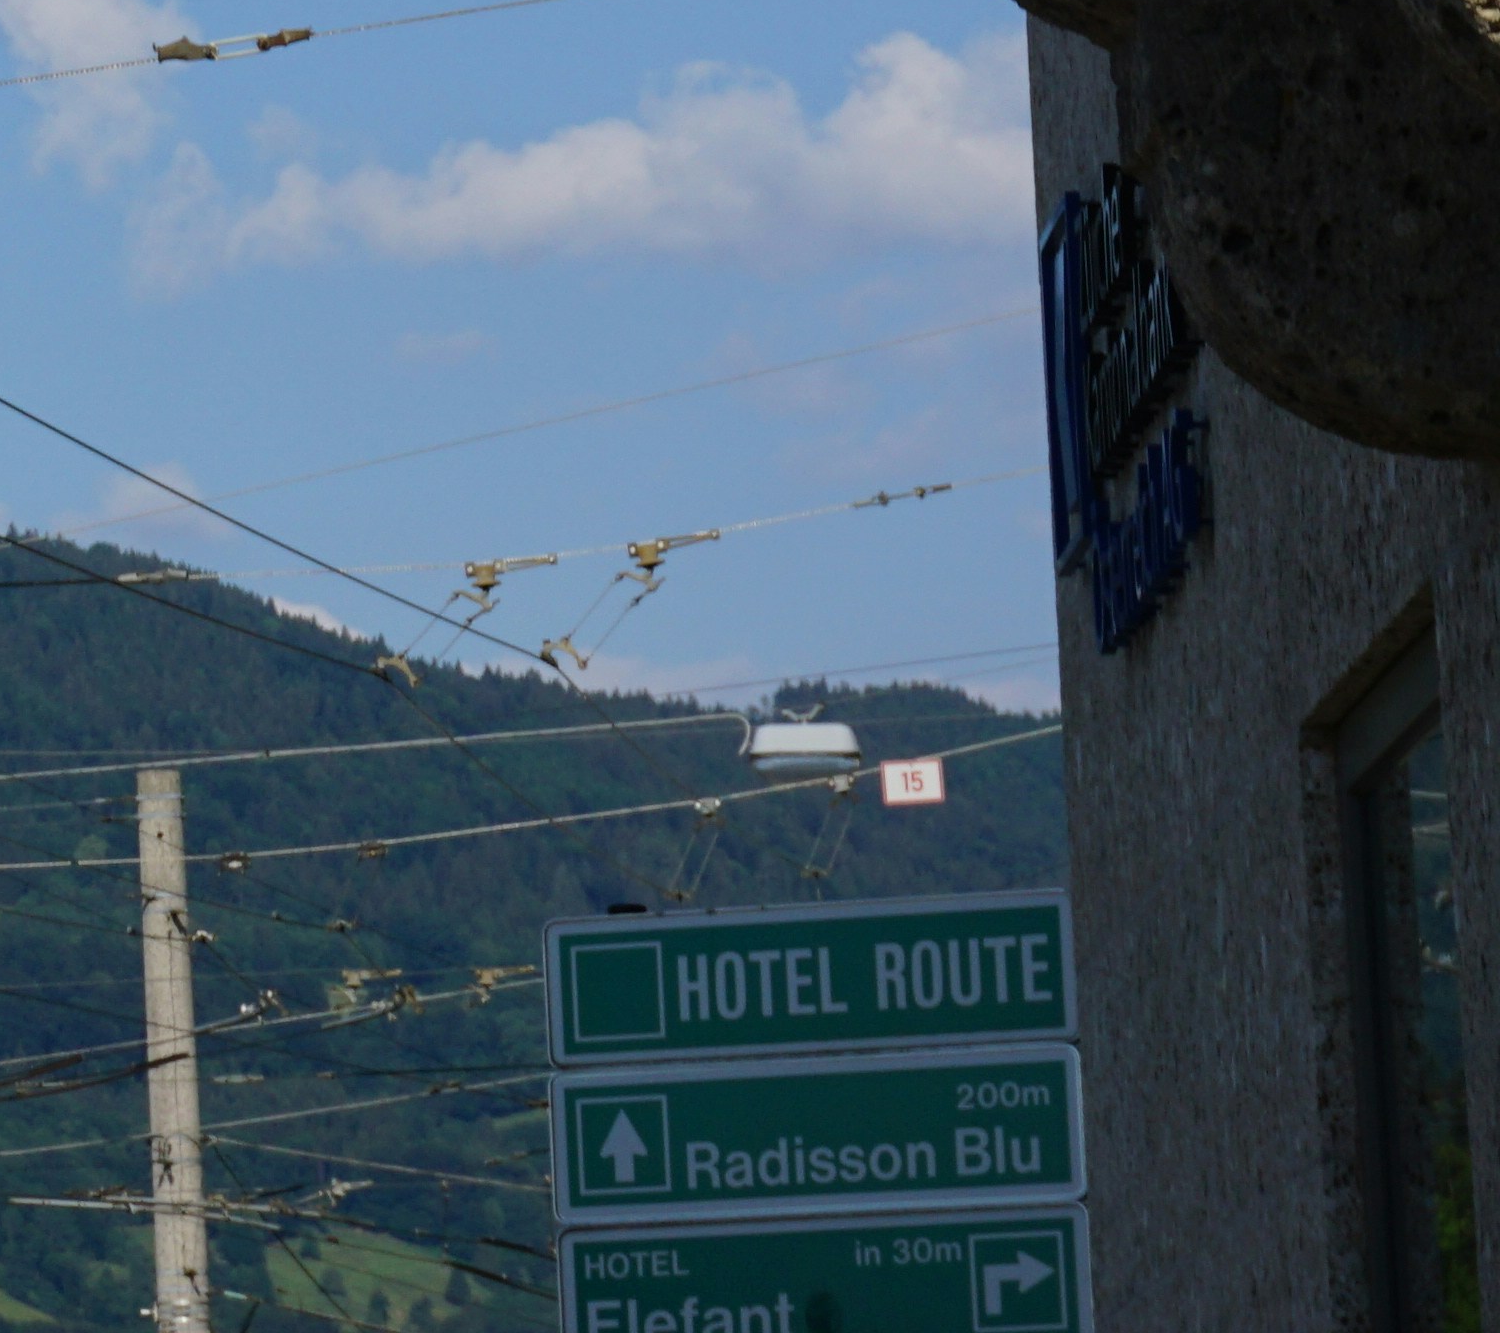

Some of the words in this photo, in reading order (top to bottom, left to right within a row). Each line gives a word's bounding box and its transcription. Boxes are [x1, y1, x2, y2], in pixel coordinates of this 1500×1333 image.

[901, 771, 925, 793] 15
[676, 946, 849, 1022] HOTEL
[874, 933, 1054, 1011] ROUTE
[956, 1081, 1051, 1111] 200m
[686, 1136, 937, 1190] Radisson
[954, 1125, 1042, 1176] Blu
[583, 1249, 690, 1280] HOTEL
[854, 1239, 882, 1266] in
[892, 1237, 962, 1265] 30m
[586, 1292, 795, 1333] Elefant
